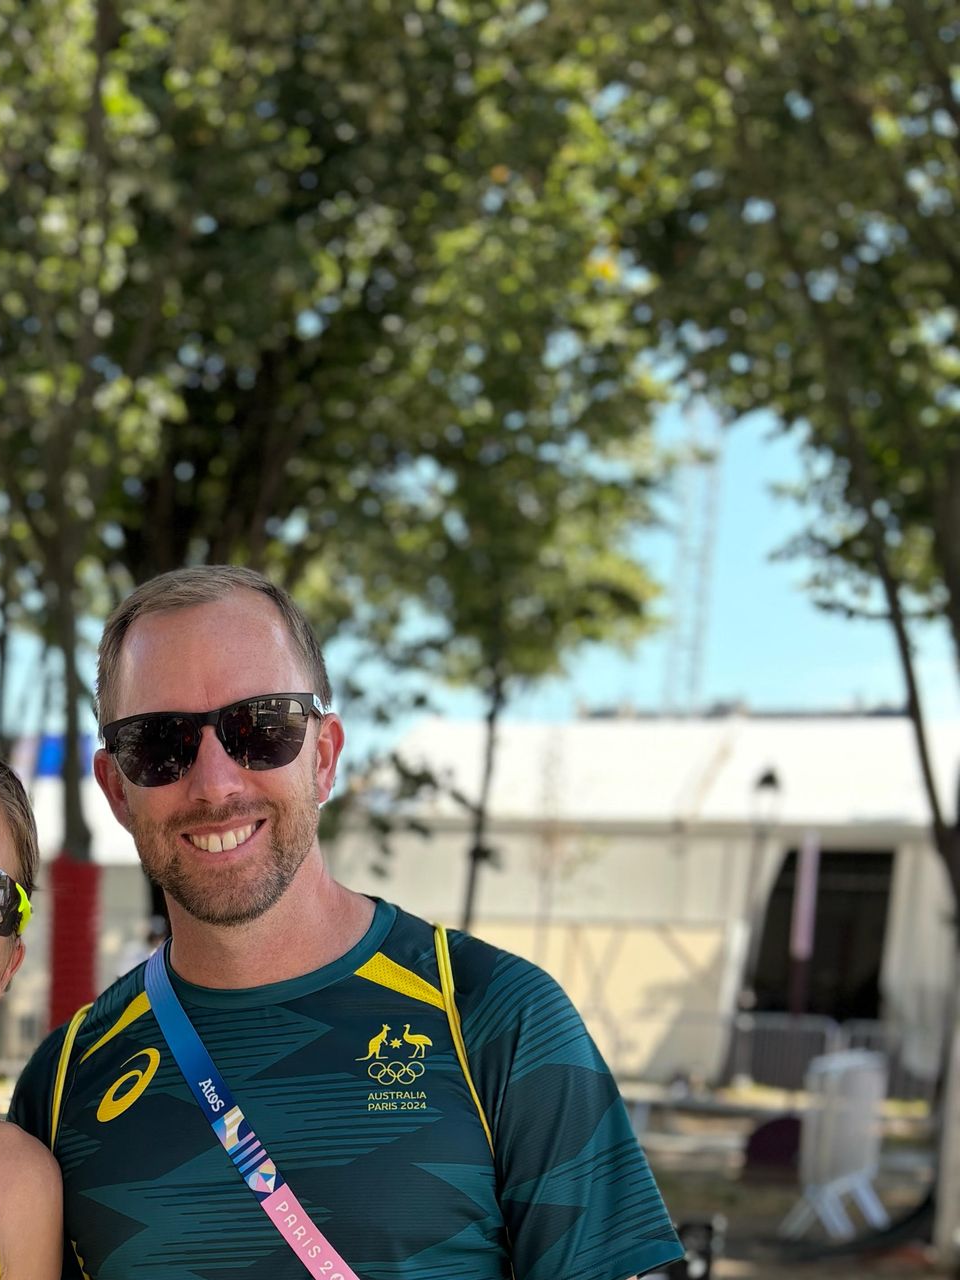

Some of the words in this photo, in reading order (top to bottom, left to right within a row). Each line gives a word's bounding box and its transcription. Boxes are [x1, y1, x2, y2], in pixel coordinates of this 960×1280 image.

[198, 1078, 225, 1112] Atos
[367, 1091, 427, 1101] AUSTRALIA
[367, 1102, 398, 1111] PARIS
[400, 1101, 427, 1110] 2024
[275, 1201, 321, 1258] PARIS
